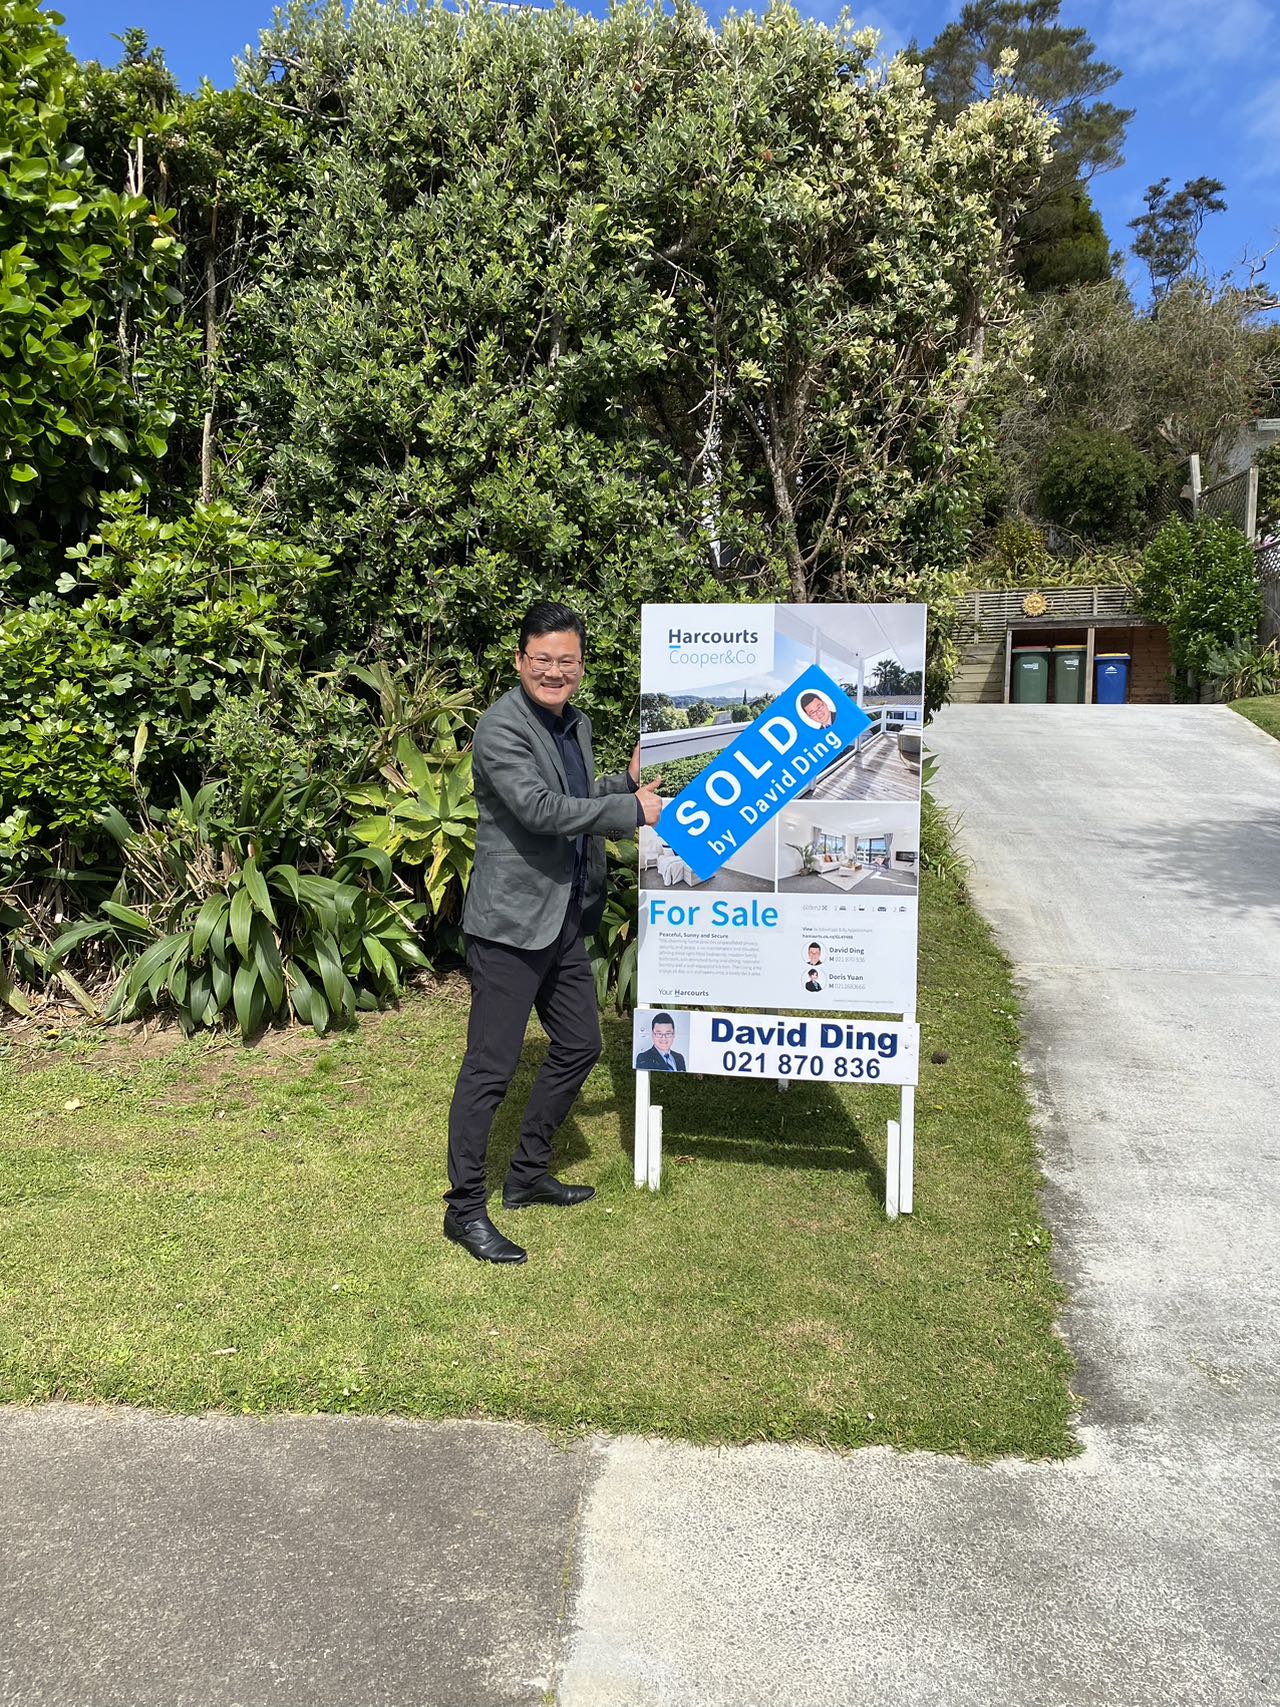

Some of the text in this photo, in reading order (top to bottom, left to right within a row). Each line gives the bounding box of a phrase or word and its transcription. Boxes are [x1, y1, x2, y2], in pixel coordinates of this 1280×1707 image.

[668, 628, 759, 644] Harcourts
[669, 649, 757, 668] Cooper&Co
[675, 716, 798, 837] SOLD
[707, 730, 843, 857] by David Ding
[650, 899, 779, 927] For Sale
[829, 946, 865, 955] David Ding
[829, 973, 846, 981] Doris
[659, 988, 709, 997] Your Harcourts
[711, 1017, 898, 1059] David Ding
[722, 1050, 881, 1080] 021 870 836
